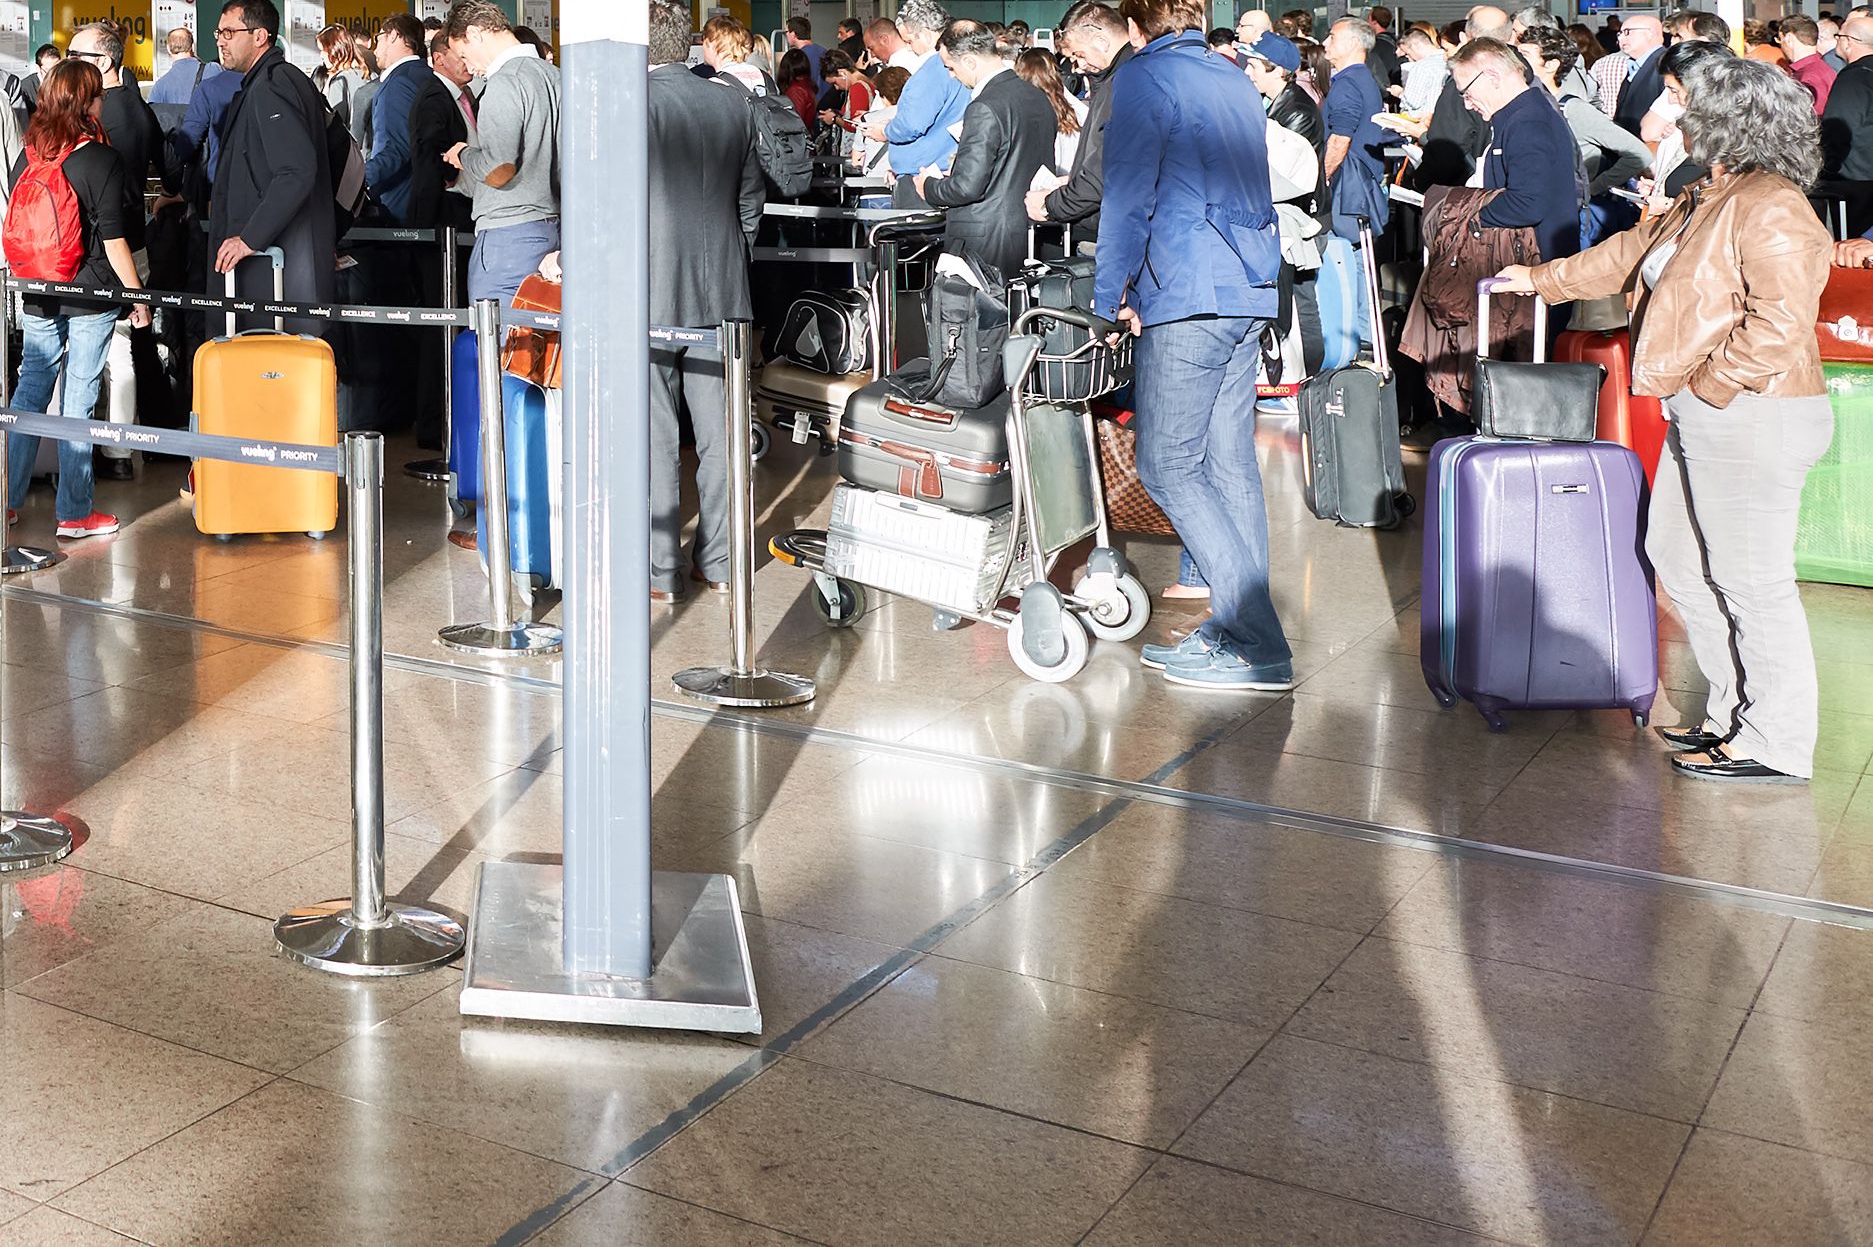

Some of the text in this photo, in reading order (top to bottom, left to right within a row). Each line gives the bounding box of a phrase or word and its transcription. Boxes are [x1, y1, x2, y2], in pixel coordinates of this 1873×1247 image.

[393, 229, 420, 240] vueling
[55, 285, 83, 294] EXCELLENCE
[93, 289, 113, 298] vueling
[122, 292, 151, 301] EXCELLENCE
[161, 296, 182, 305] vueling
[191, 299, 222, 307] EXCELLENCE
[233, 302, 255, 312] vueling
[264, 305, 297, 313] EXCELLENCE
[309, 307, 331, 317] vueling
[341, 309, 376, 318] EXCELLENCE
[387, 311, 410, 322] vueling
[421, 312, 456, 321] EXCELLENCE
[90, 425, 160, 444] vueling PRIORITY
[240, 445, 318, 462] vueling PRIORITY
